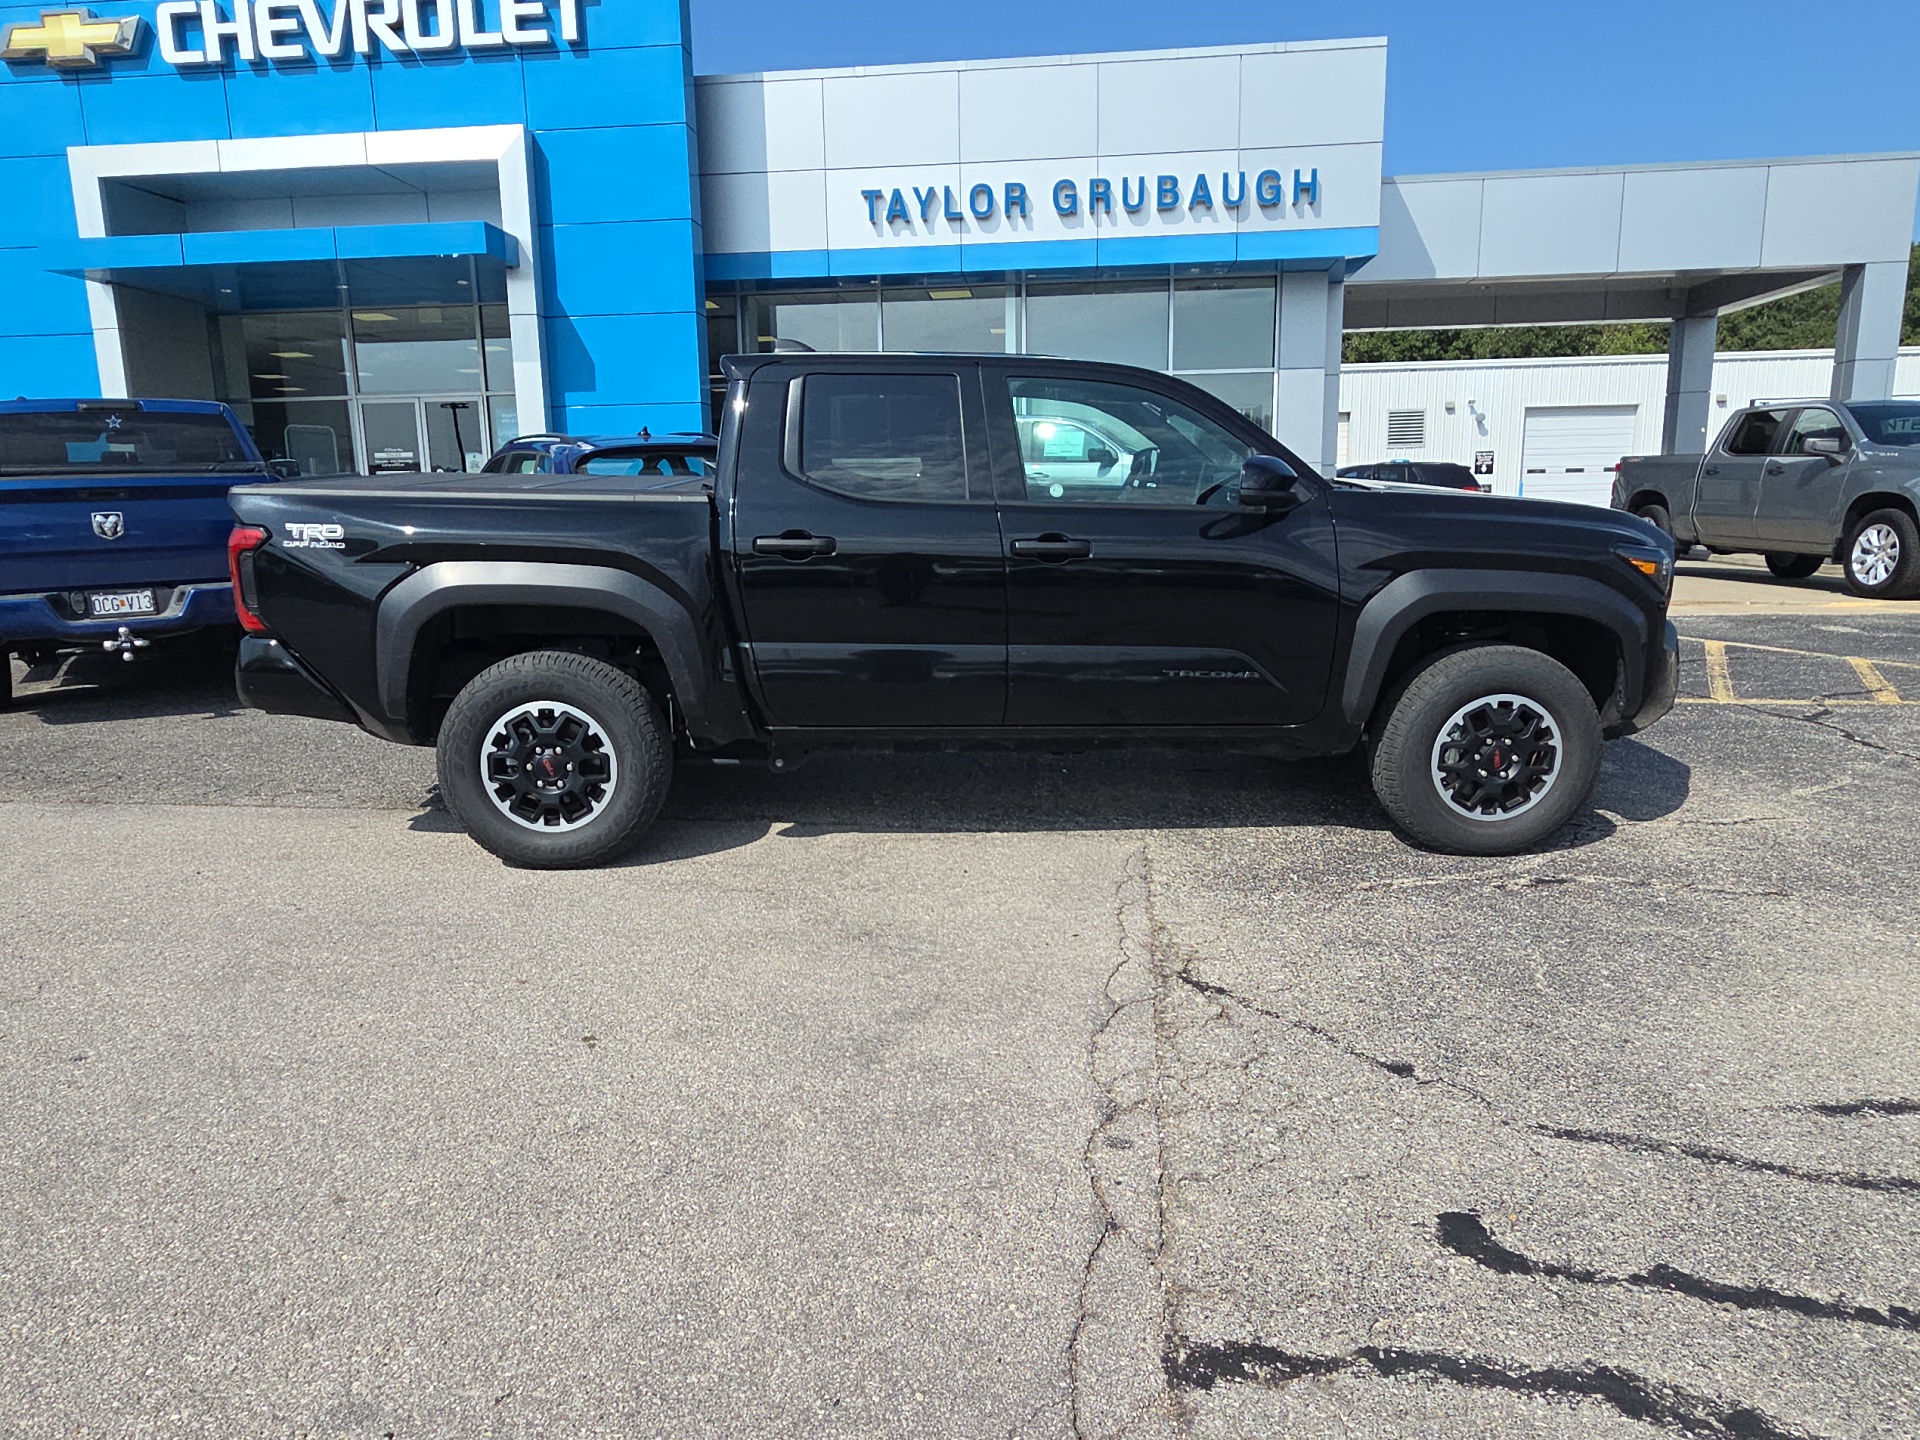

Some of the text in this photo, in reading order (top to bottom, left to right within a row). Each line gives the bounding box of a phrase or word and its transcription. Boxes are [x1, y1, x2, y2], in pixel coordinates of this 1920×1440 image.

[156, 0, 579, 64] CHEVROLET
[860, 167, 1319, 225] TAYLOR GRUBAUGH
[284, 522, 345, 541] TRD
[282, 540, 346, 549] OFF ROAD
[1162, 669, 1260, 679] TACOMA
